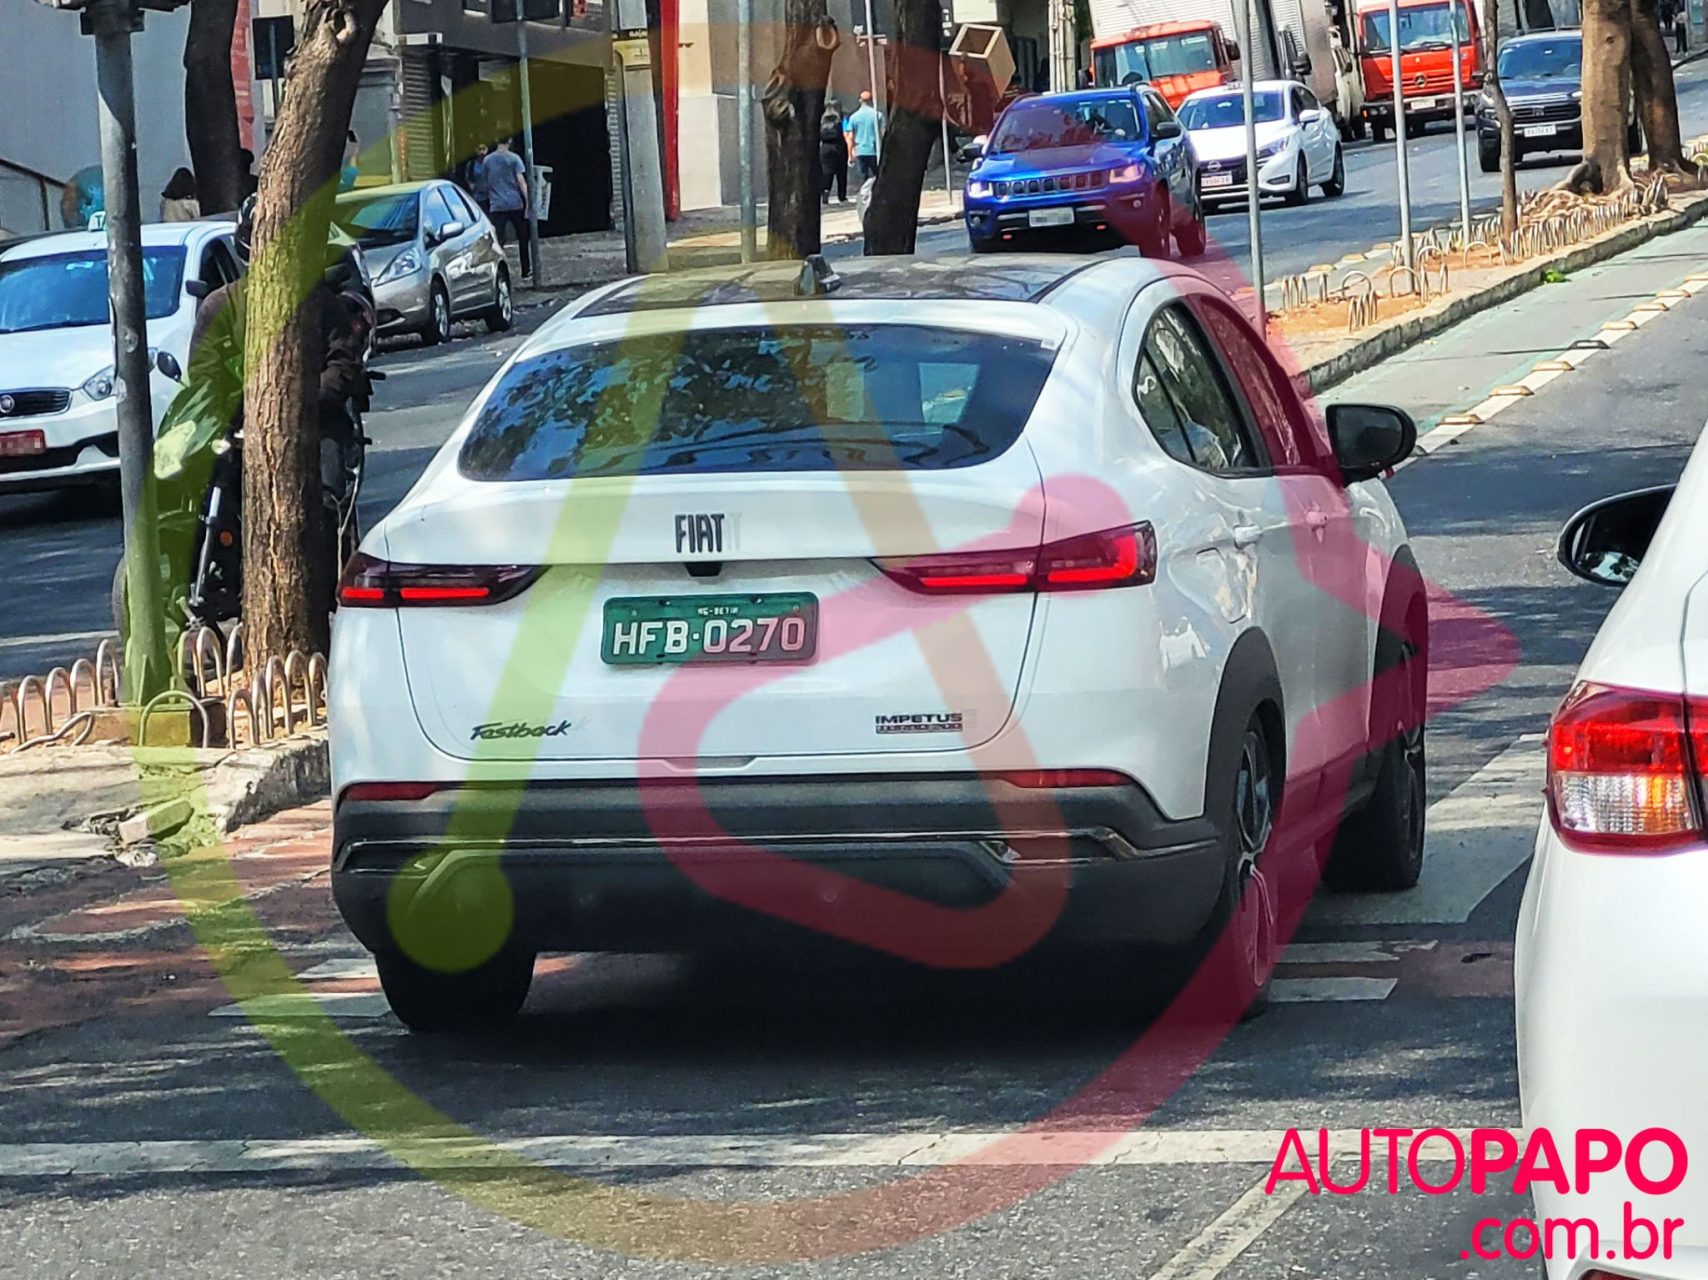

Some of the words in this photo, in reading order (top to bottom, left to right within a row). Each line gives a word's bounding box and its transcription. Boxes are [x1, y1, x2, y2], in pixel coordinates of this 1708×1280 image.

[674, 513, 725, 553] FIAT
[875, 713, 962, 724] IMPETUS
[470, 719, 572, 740] Fastback
